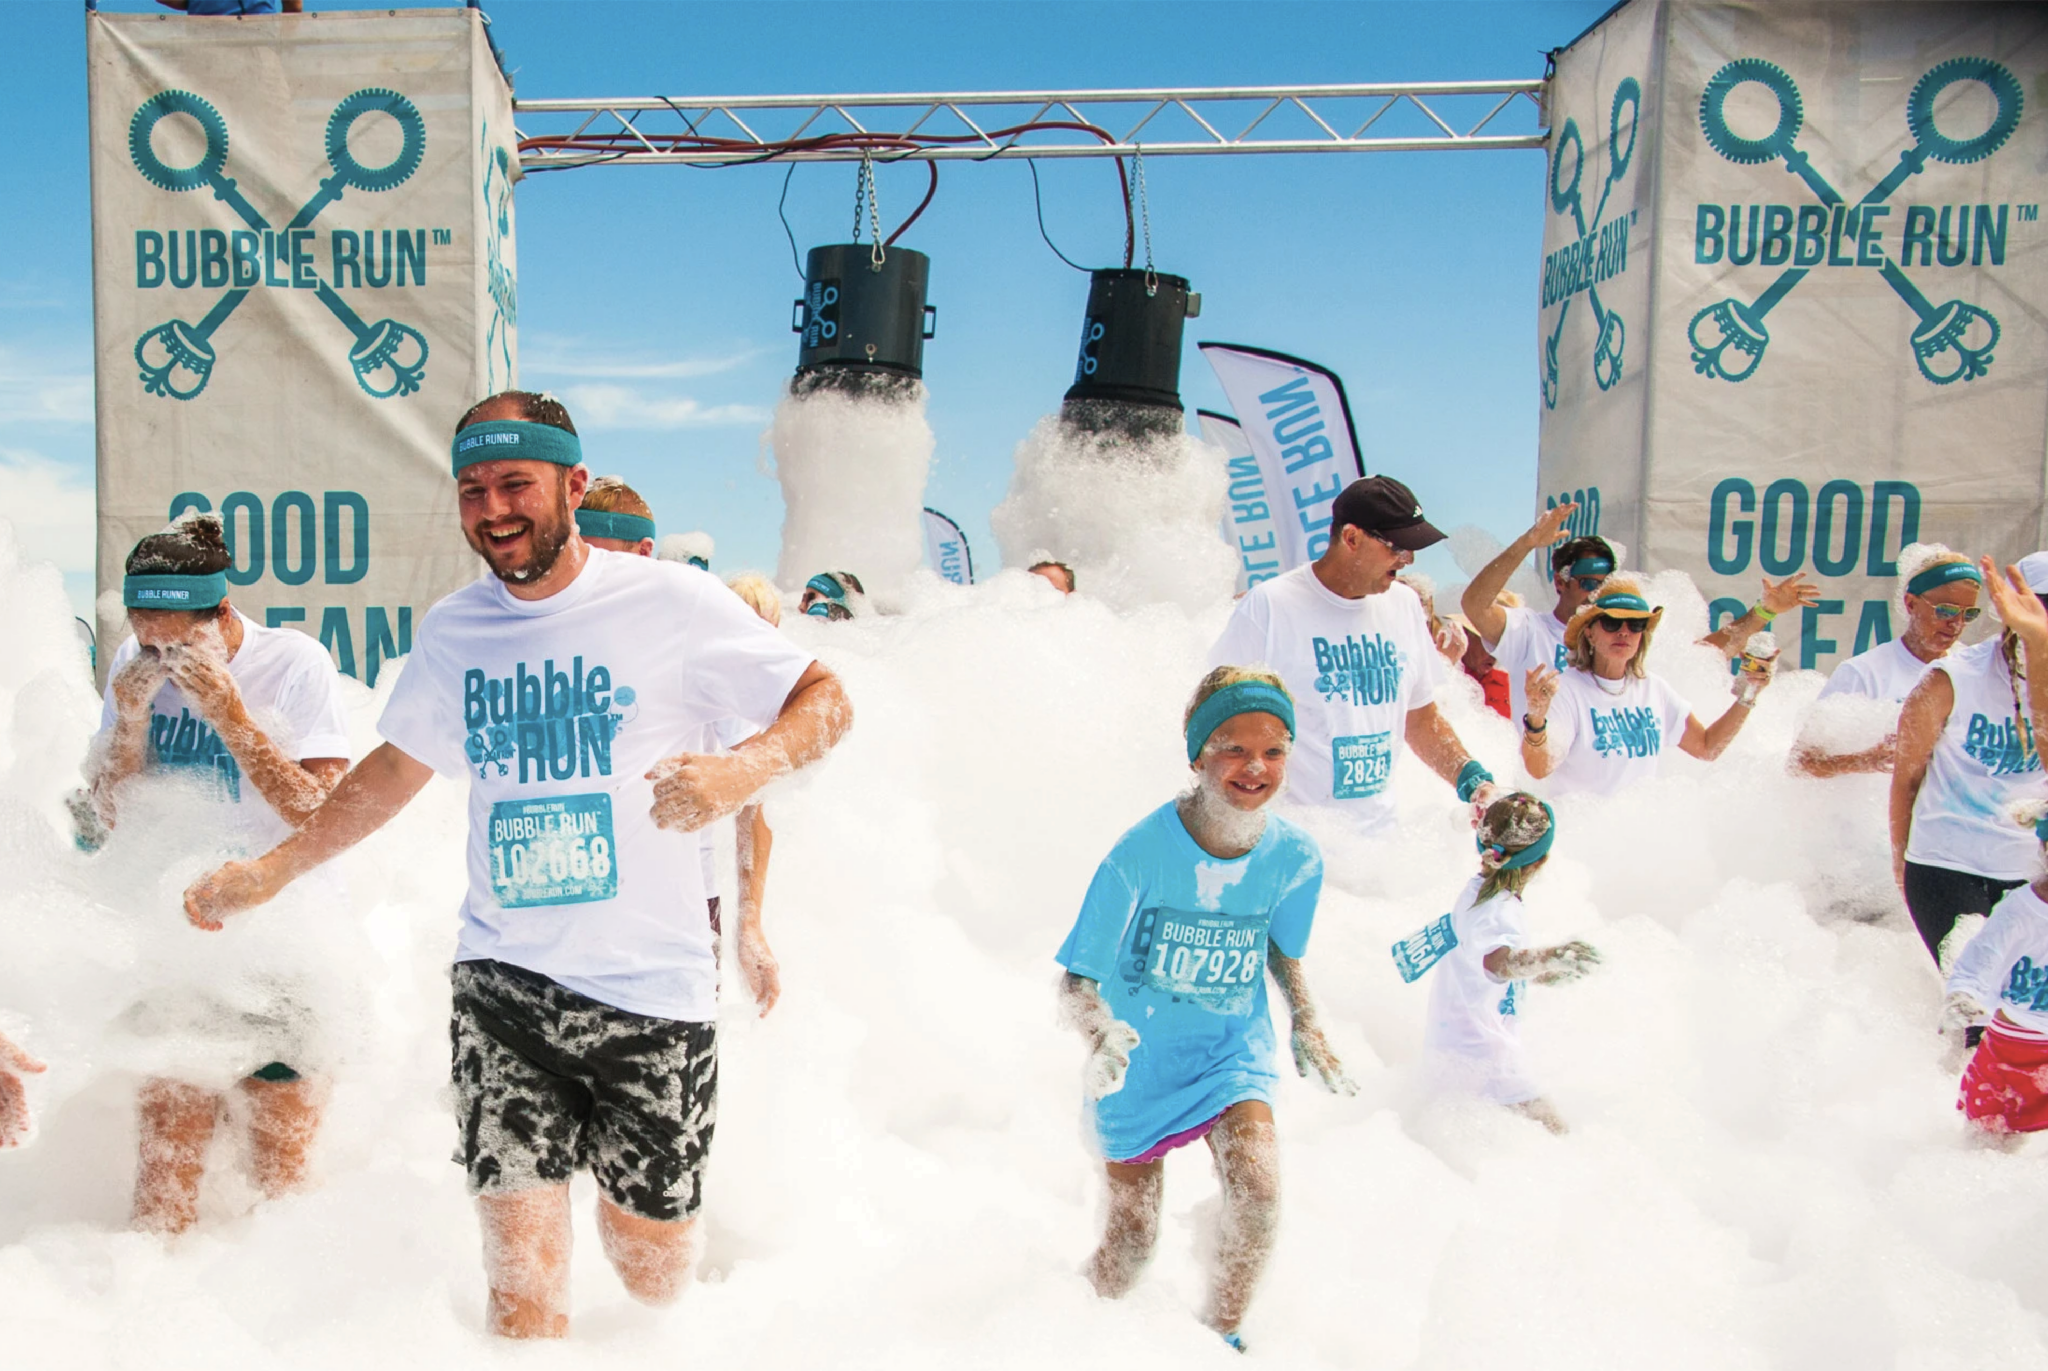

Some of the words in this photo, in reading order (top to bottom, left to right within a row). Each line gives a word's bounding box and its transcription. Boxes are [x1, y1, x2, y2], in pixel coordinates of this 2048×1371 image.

[1695, 203, 1890, 267] BUBBLE
[135, 229, 319, 289] BUBBLE
[1542, 231, 1598, 309] BUBBLE
[459, 435, 484, 452] BUBBLE
[485, 433, 520, 445] RUNNER
[1707, 477, 1922, 577] GOOD
[137, 589, 161, 599] BUBBLE
[161, 589, 190, 600] RUNNER
[1312, 633, 1398, 673] Bubble
[464, 655, 612, 730] Bubble
[494, 815, 555, 842] BUBBLE
[1162, 921, 1224, 947] BUBBLE
[1151, 942, 1259, 984] 107928
